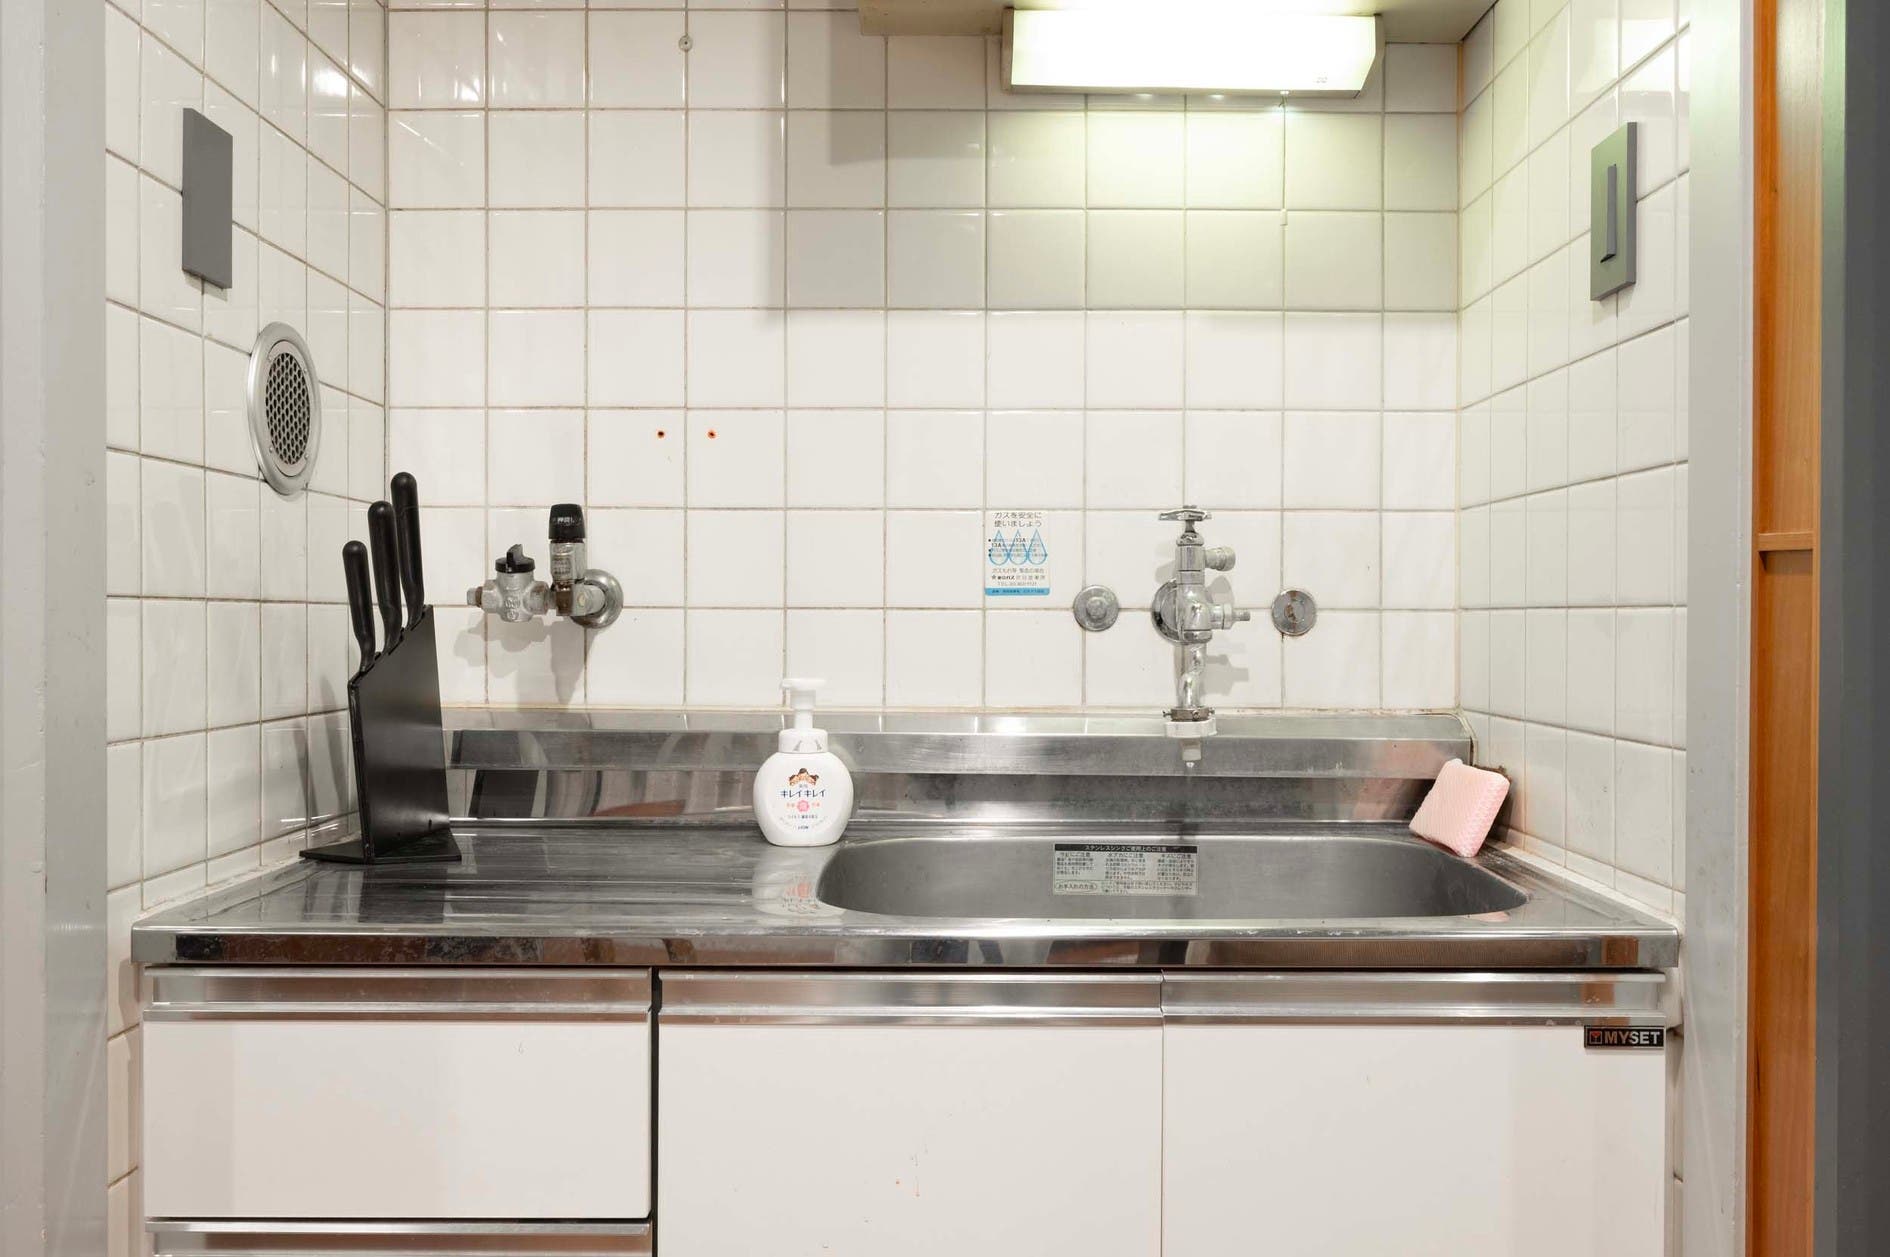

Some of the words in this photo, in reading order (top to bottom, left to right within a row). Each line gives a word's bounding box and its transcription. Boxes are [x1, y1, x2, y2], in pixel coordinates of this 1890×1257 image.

[780, 790, 826, 798] キレイキレイ
[1604, 1031, 1660, 1044] MYSET
